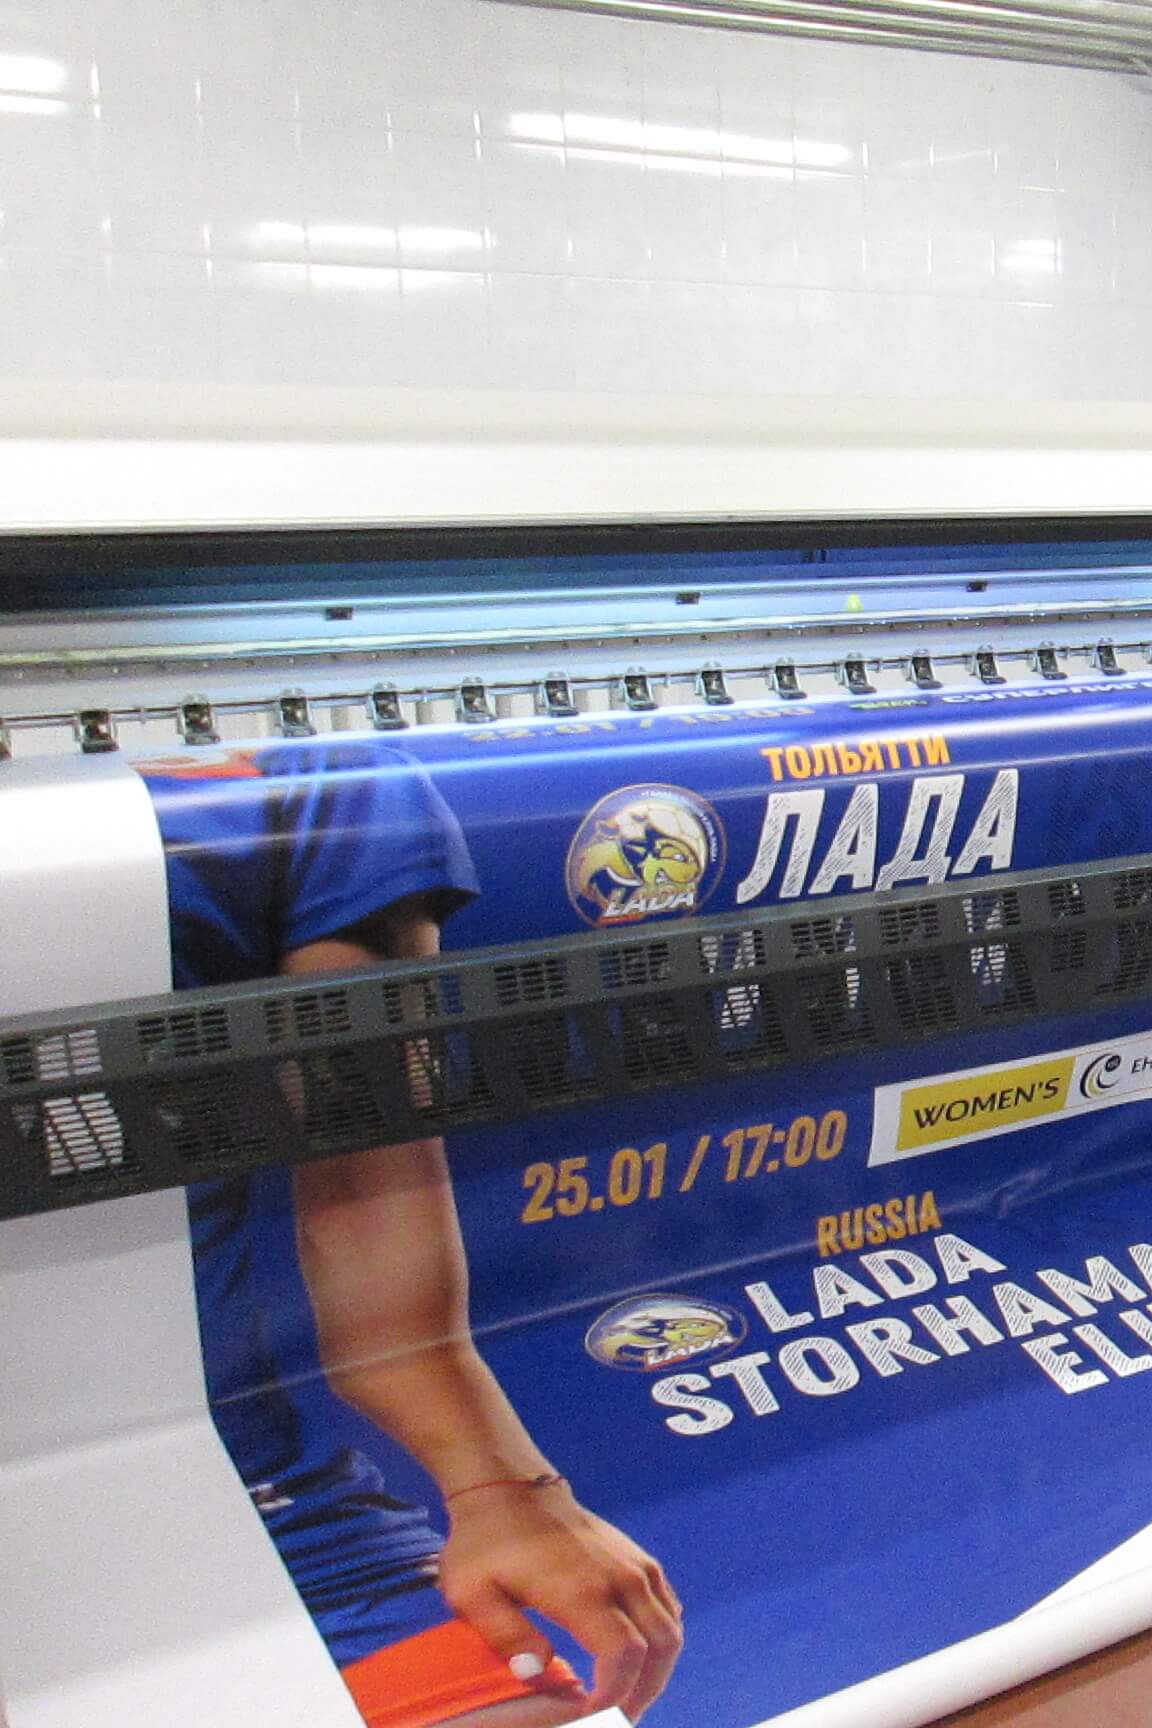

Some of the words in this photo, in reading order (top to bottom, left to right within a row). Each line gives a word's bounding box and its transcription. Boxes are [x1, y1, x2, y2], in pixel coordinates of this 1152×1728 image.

[761, 736, 951, 781] ТОЛЬЯТТИ
[737, 768, 1020, 904] ЛАДА
[602, 892, 695, 916] LADA
[913, 1076, 1060, 1130] WOMEN'S
[520, 1142, 667, 1224] 25.01
[680, 1135, 709, 1192] /
[721, 1110, 848, 1182] 17:00
[816, 1191, 942, 1257] RUSSIA
[744, 1233, 1008, 1333] LADA
